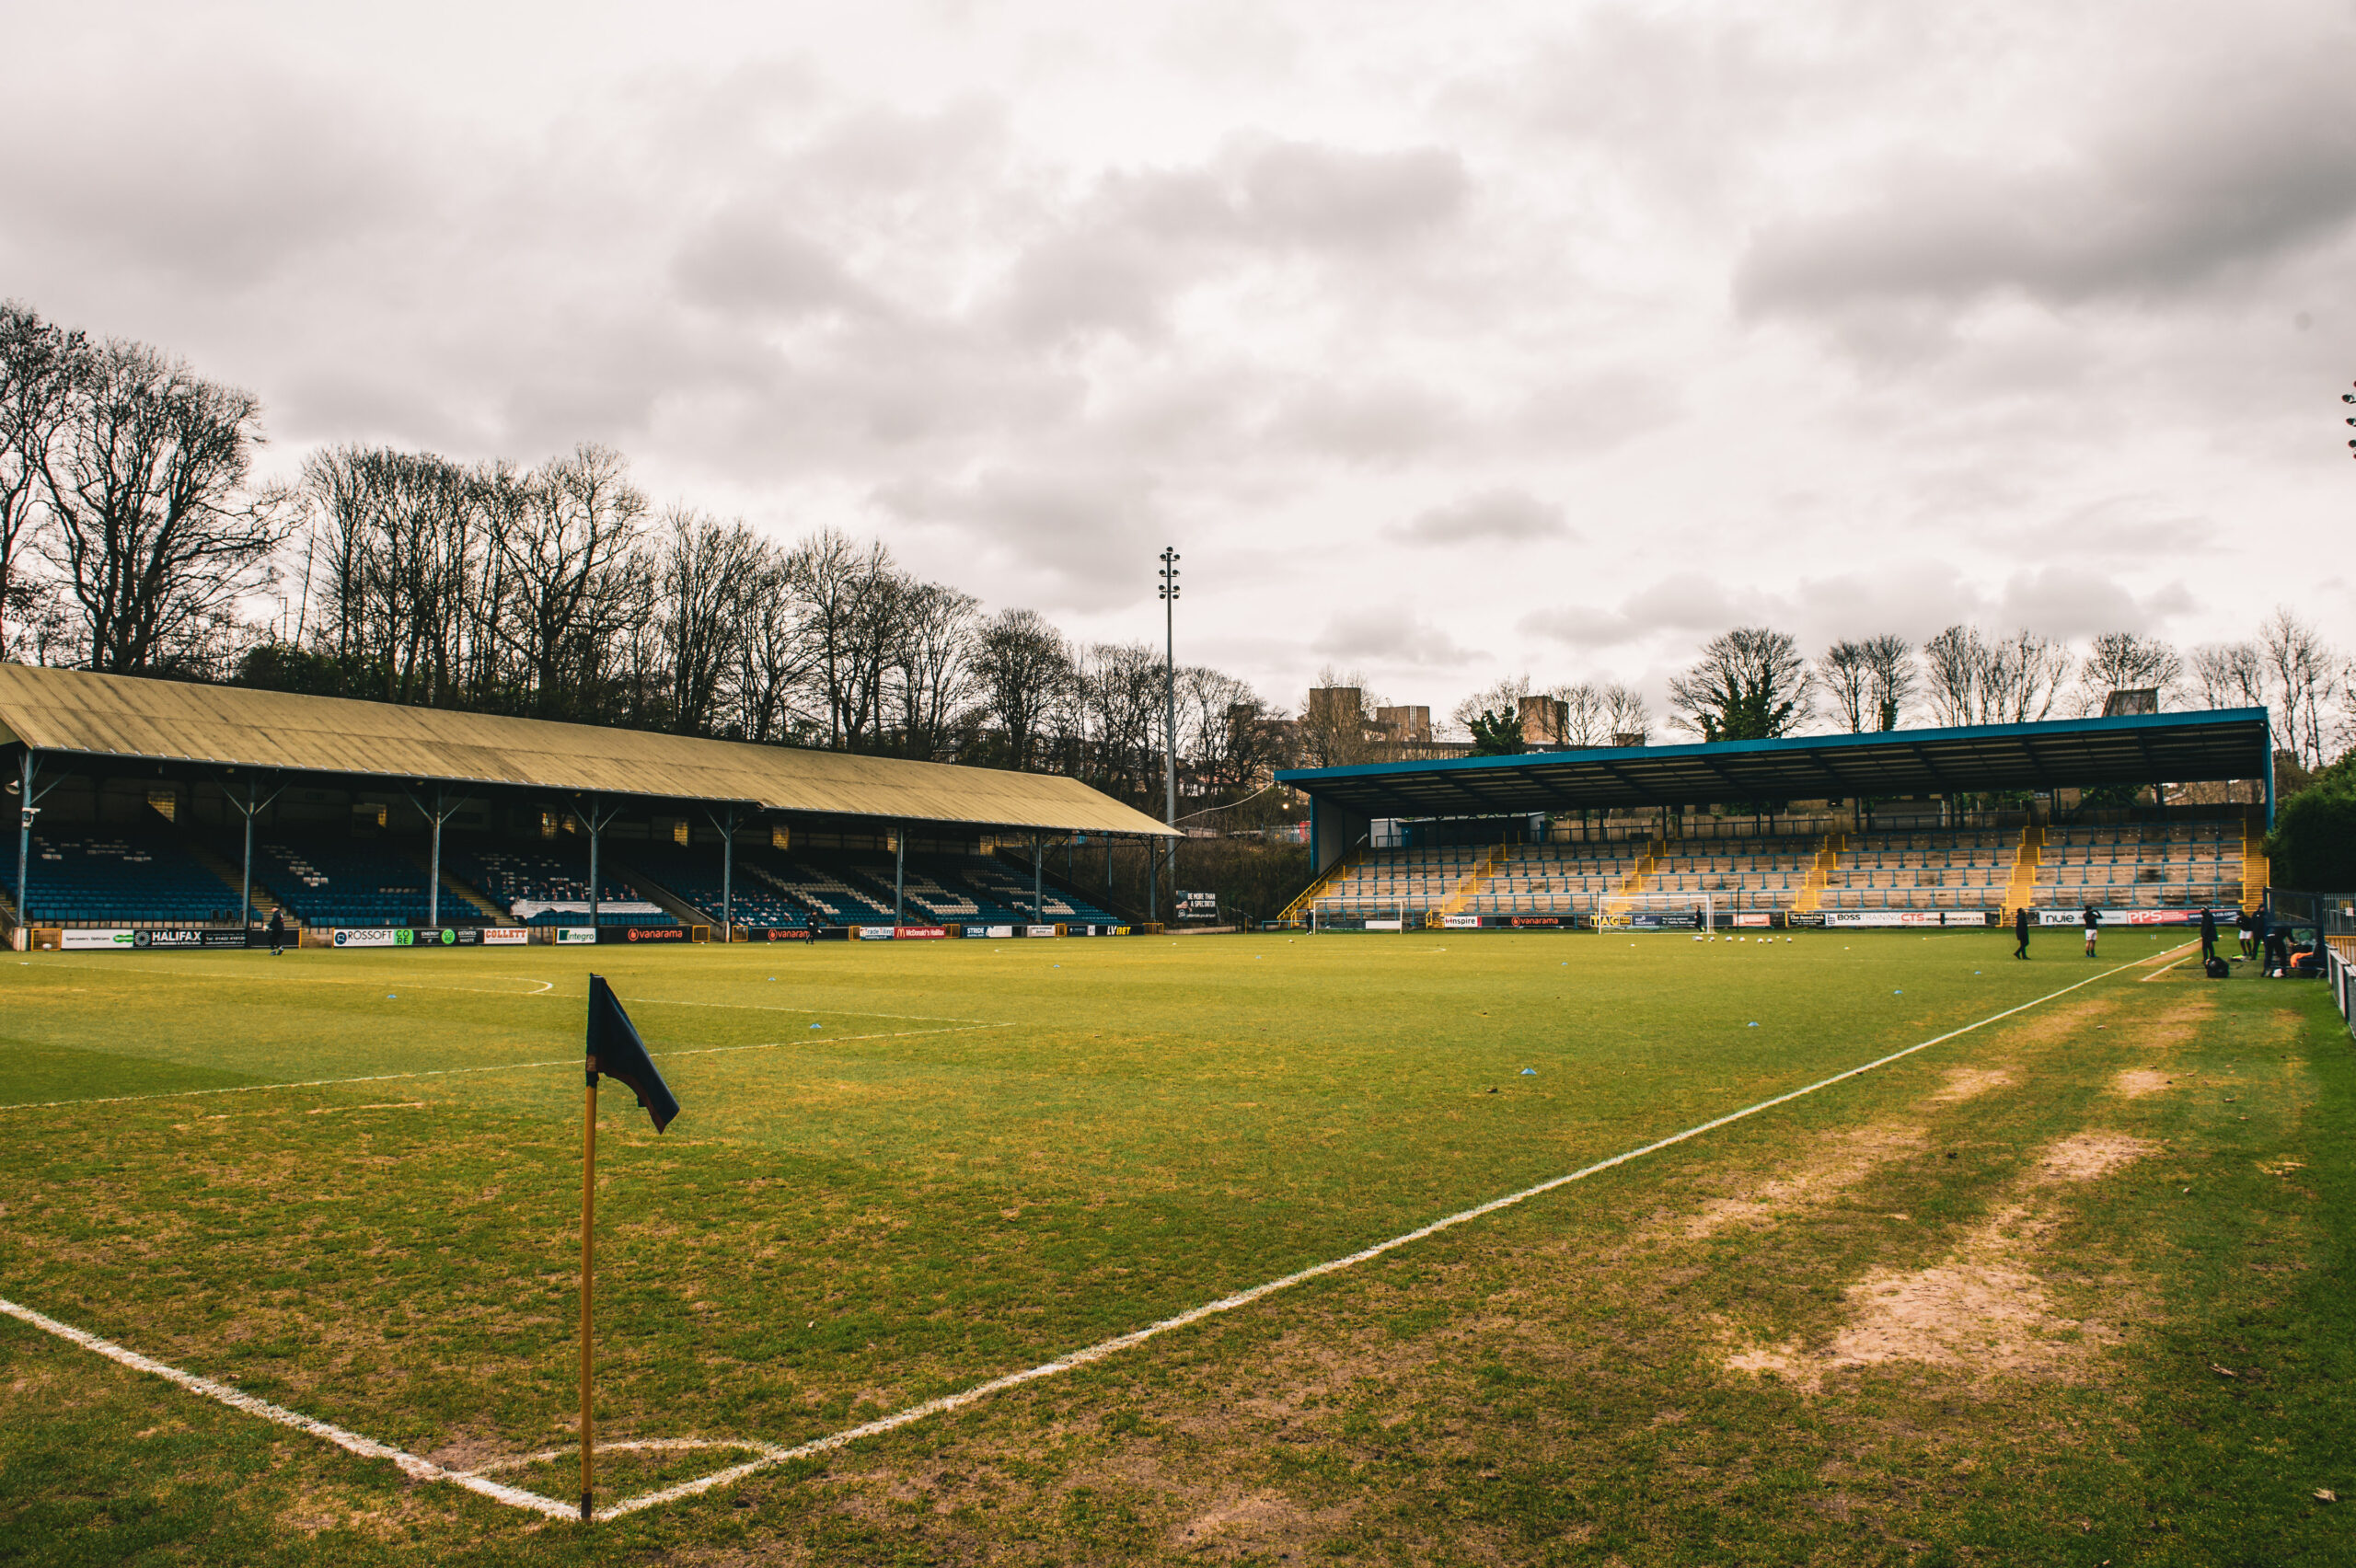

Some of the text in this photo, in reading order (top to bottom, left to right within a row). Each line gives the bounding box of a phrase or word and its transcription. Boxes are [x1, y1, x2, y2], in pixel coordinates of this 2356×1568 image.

[1520, 917, 1559, 925] vanarama
[1591, 916, 1620, 926] TAG
[1861, 913, 1900, 921] TRAINING
[1900, 913, 1925, 922] CTS
[2045, 912, 2075, 923] nuie
[2127, 910, 2164, 923] PPS
[152, 931, 202, 941] HALIFAX
[348, 930, 392, 940] ROSSOFT
[485, 929, 526, 939] COLLETT
[639, 929, 683, 939] vanarama
[906, 928, 945, 937] McDonald's Halifax
